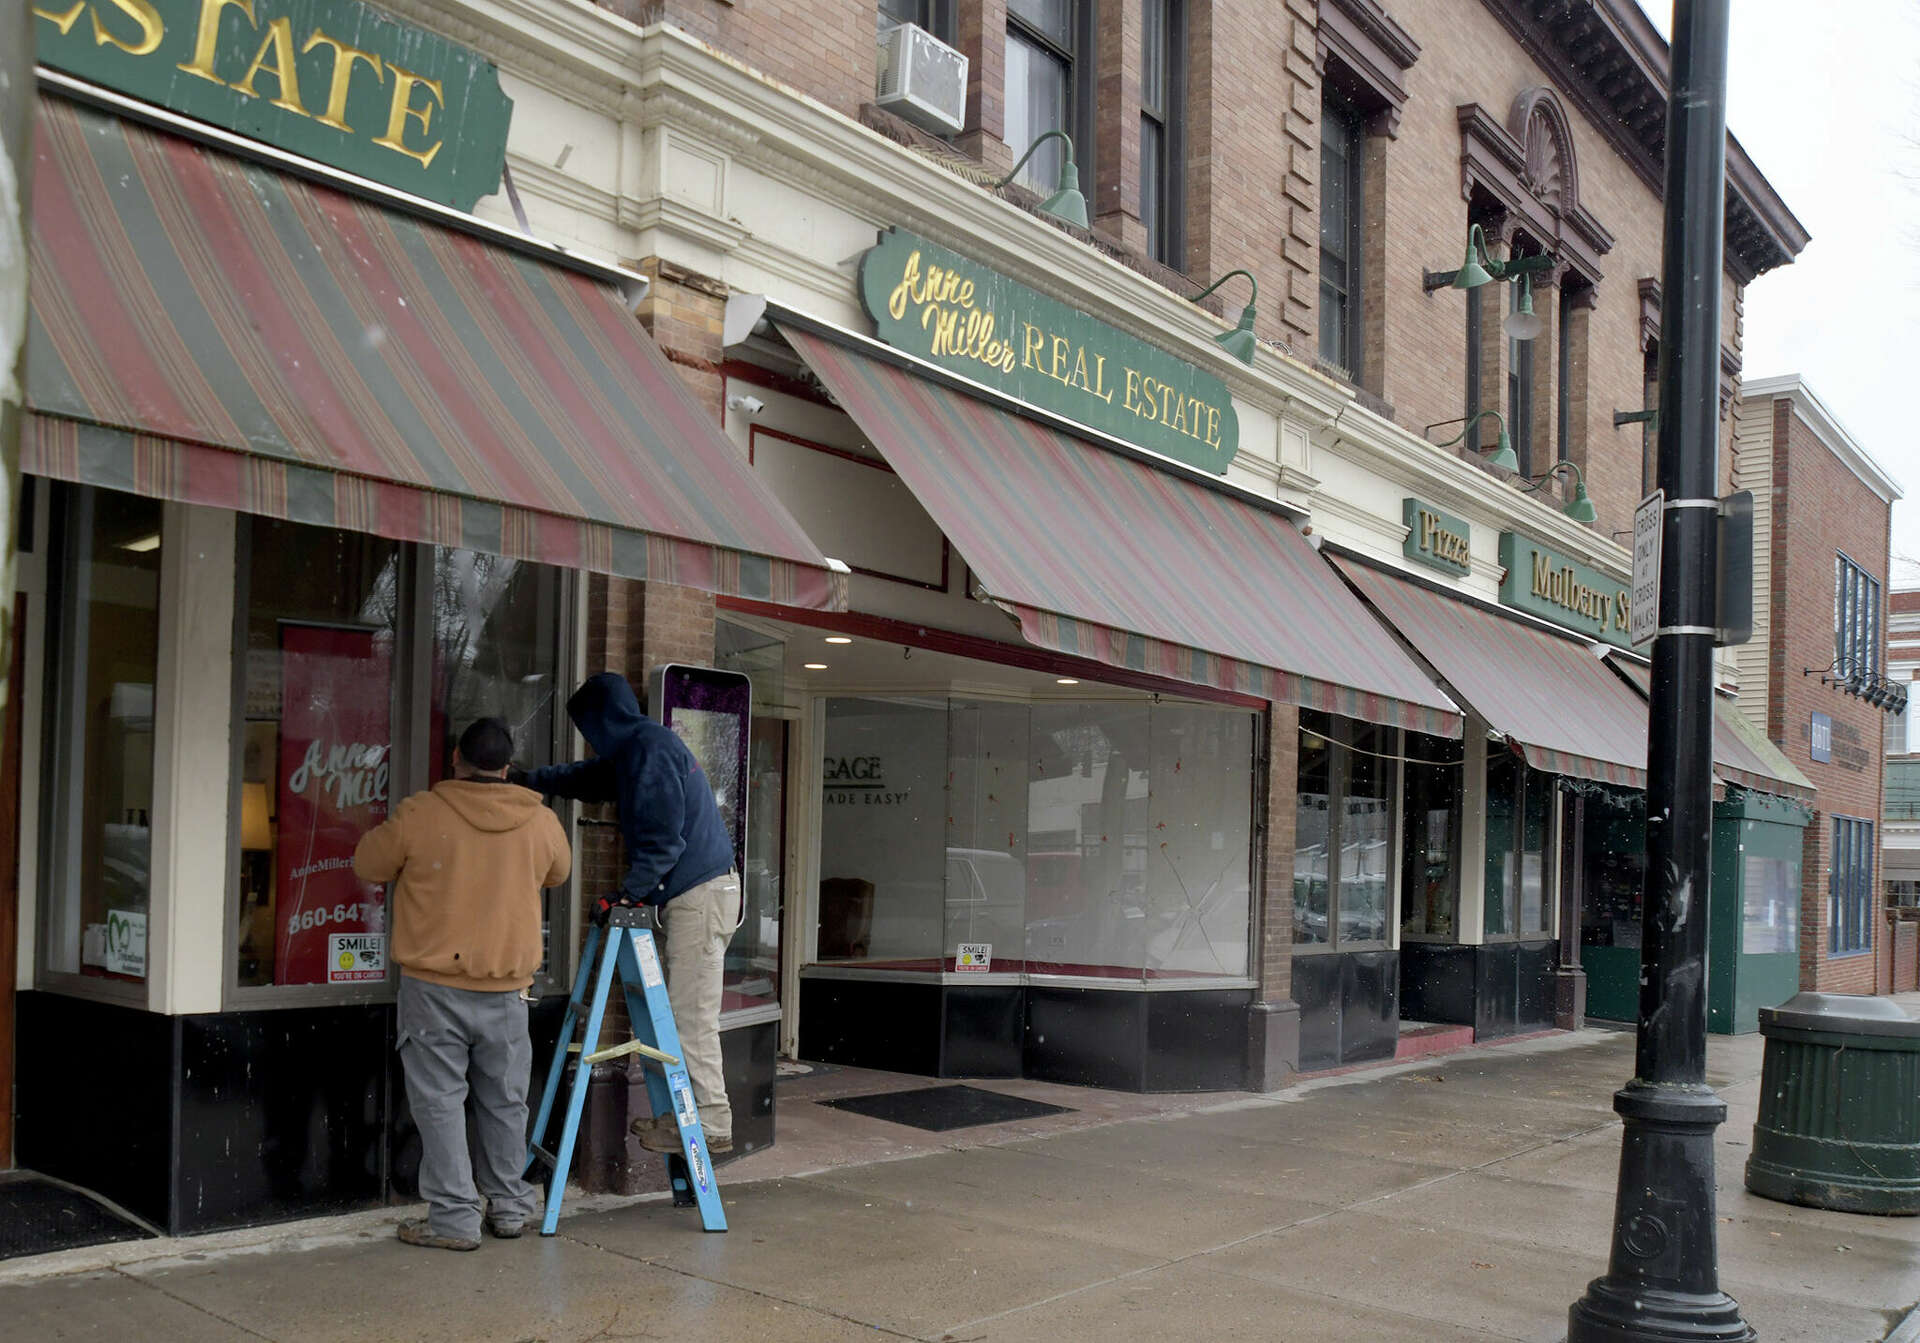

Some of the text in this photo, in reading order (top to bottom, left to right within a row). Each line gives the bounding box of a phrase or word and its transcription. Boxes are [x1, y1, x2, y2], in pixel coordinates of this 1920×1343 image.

[889, 250, 974, 320] Anne
[921, 303, 1015, 373] Miller
[1022, 321, 1222, 451] REAL ESTATE
[1419, 509, 1471, 568] Pizza
[1636, 509, 1657, 537] CROSS
[1637, 538, 1655, 562] ONLY
[1531, 550, 1611, 632] Mulberry
[1635, 580, 1654, 606] CROSS
[823, 756, 882, 779] GAGE
[822, 793, 857, 805] ADE
